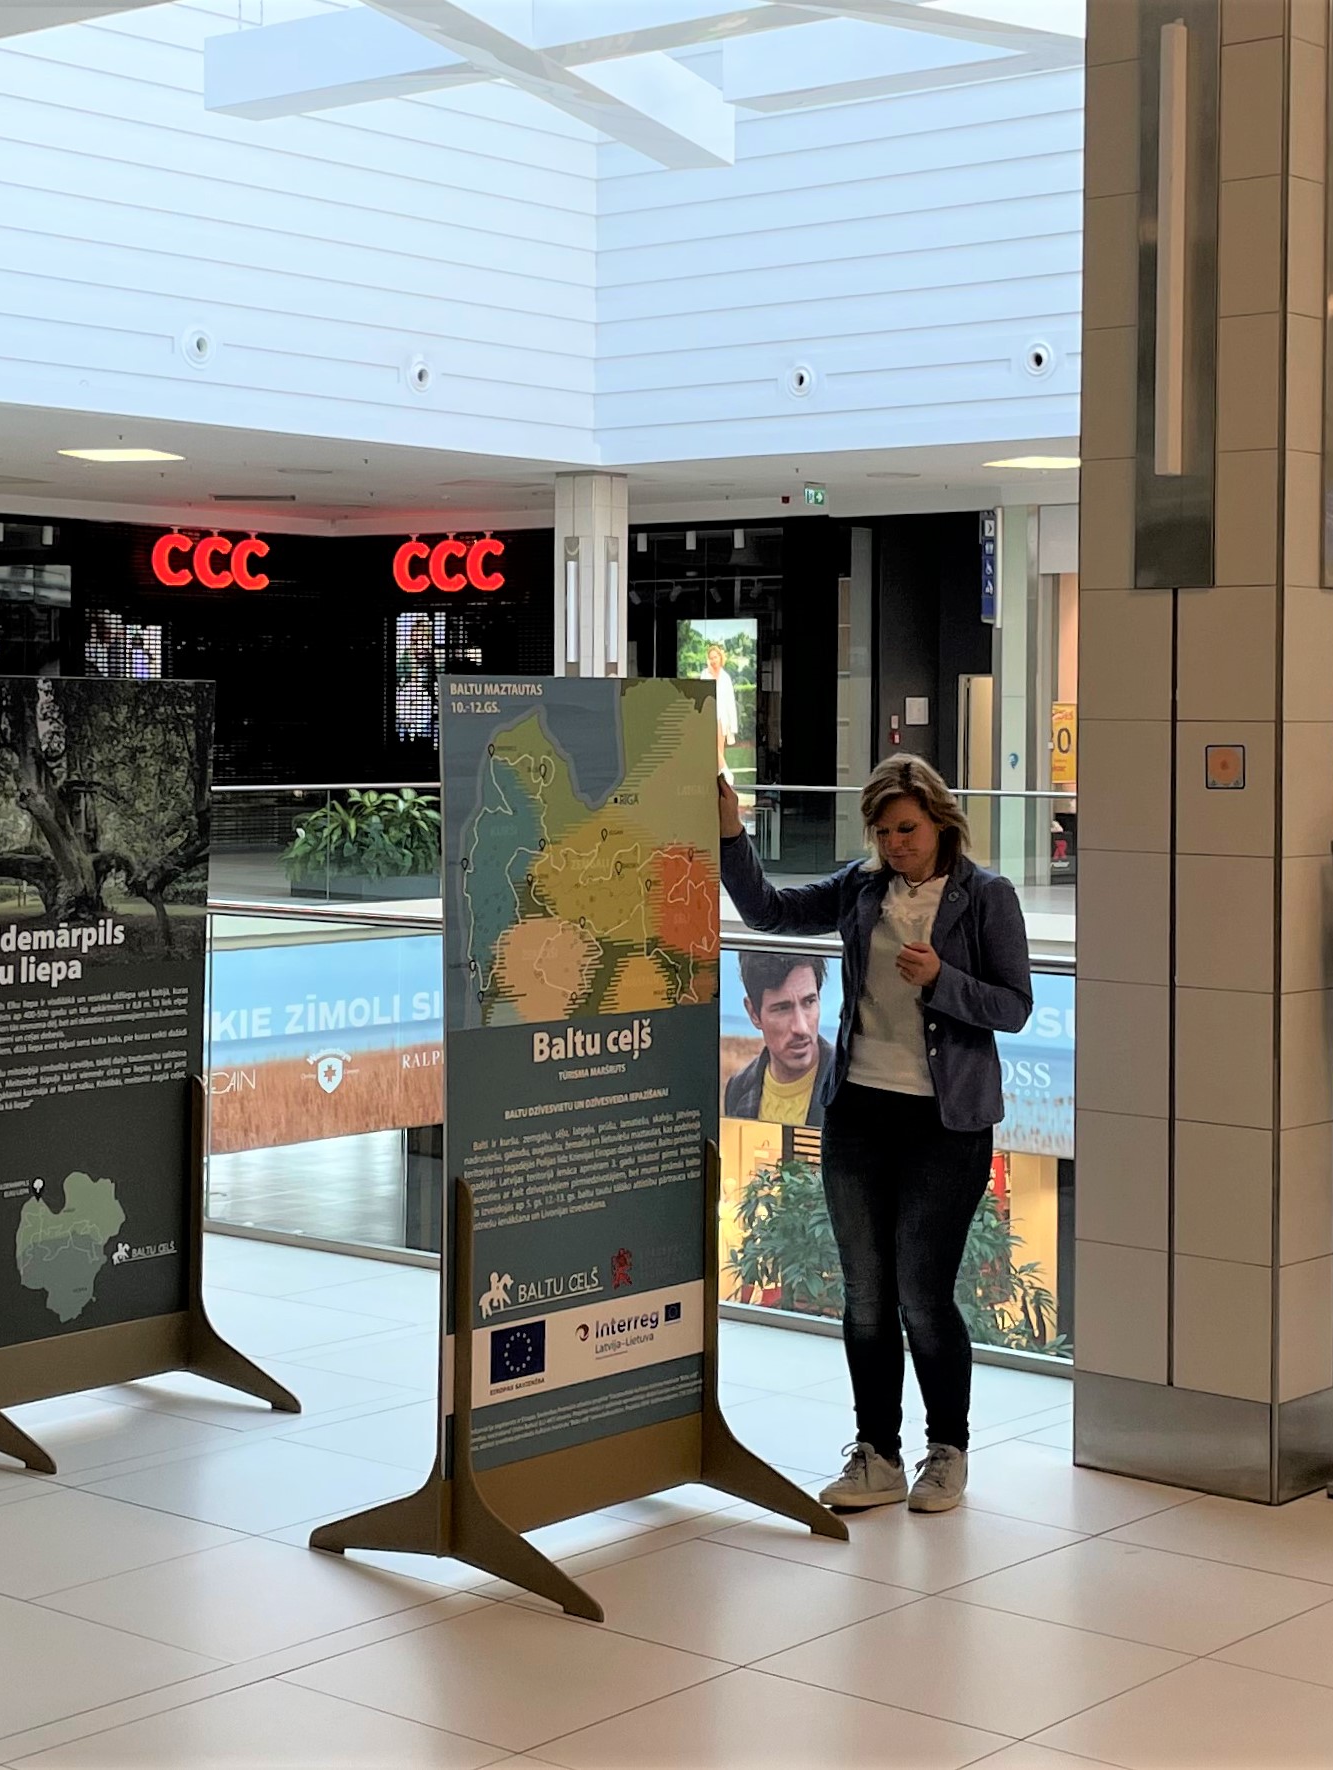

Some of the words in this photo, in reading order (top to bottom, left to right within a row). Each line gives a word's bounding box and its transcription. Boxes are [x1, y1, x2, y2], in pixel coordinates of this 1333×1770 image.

[152, 534, 270, 590] CCC
[393, 539, 505, 592] CCC
[450, 683, 482, 696] BALTU
[484, 683, 543, 695] MAZTAUTAS
[20, 956, 82, 988] liepa
[285, 994, 399, 1035] ZĪMOLI
[533, 1026, 601, 1062] Baltu
[607, 1018, 652, 1060] ceļš
[403, 1050, 444, 1069] RALP
[505, 1108, 527, 1120] BALTU
[518, 1276, 564, 1303] BALTU
[569, 1266, 599, 1292] CEĻŠ
[595, 1310, 659, 1339] Interreg
